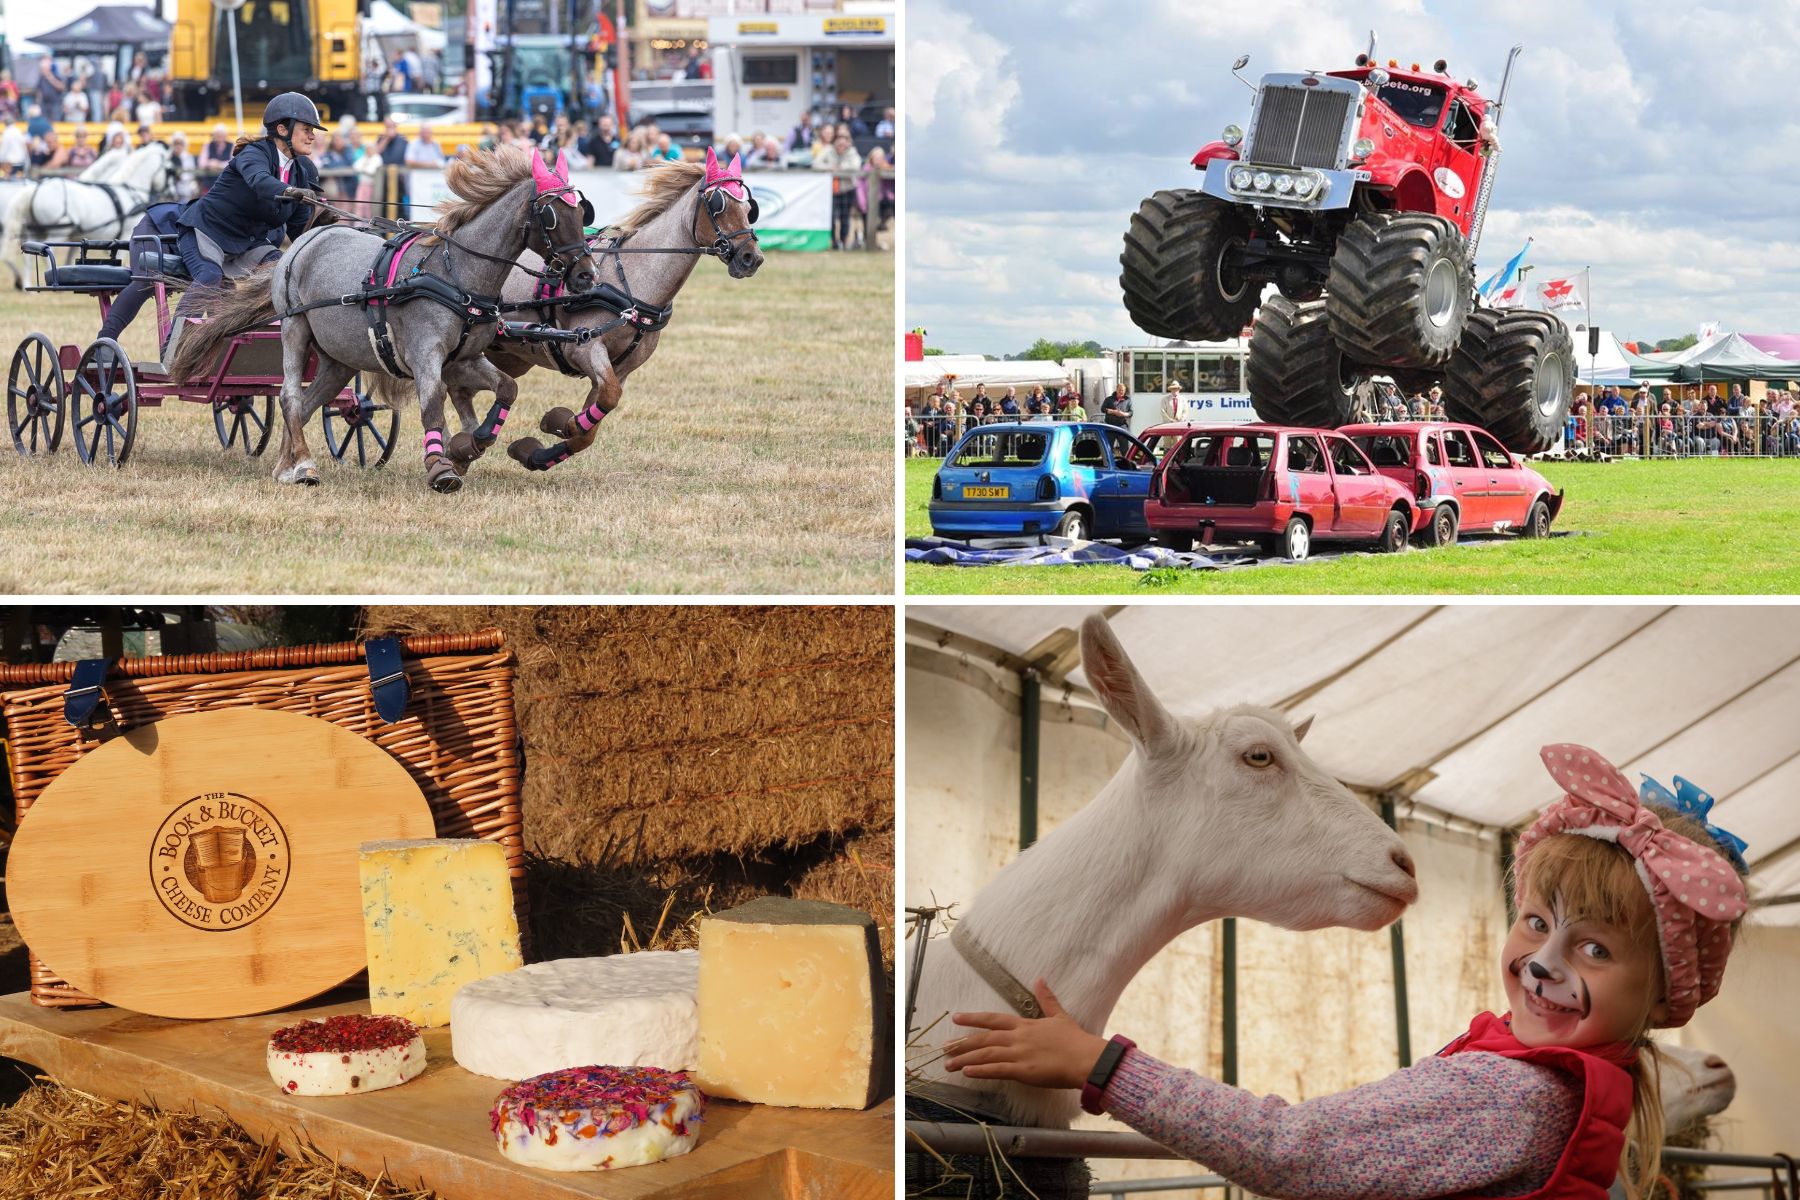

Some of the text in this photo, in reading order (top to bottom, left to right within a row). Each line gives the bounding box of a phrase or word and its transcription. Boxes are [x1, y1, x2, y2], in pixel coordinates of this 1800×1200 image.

[1188, 397, 1251, 410] rys Limi
[966, 487, 987, 497] T730
[204, 792, 225, 801] THE
[159, 801, 279, 860] BOOK & BUCKET
[160, 864, 281, 925] CHEESE COMPANY
